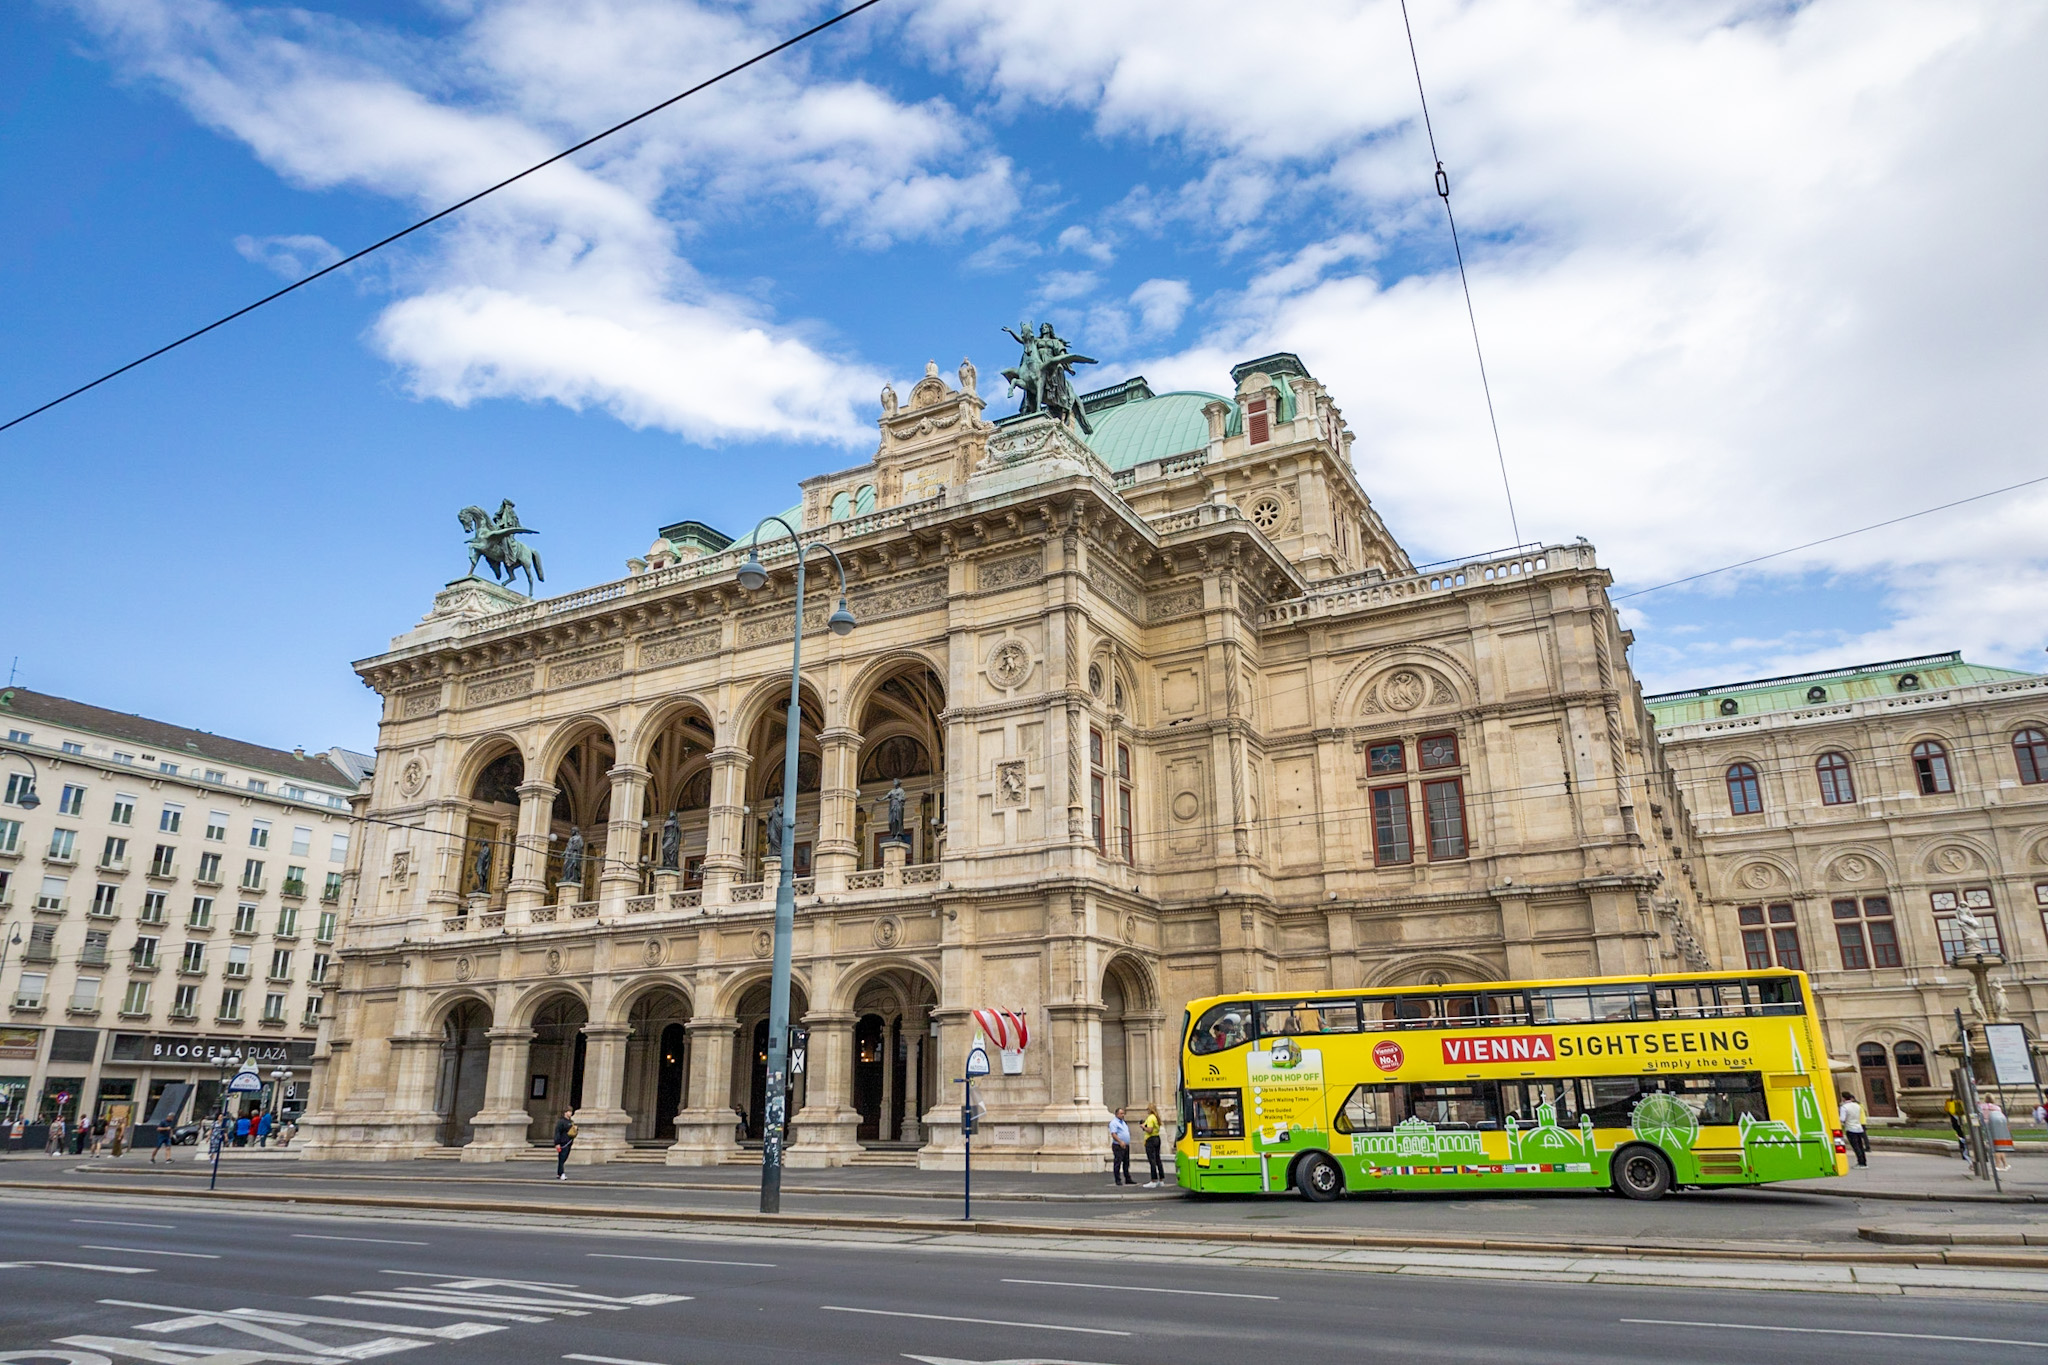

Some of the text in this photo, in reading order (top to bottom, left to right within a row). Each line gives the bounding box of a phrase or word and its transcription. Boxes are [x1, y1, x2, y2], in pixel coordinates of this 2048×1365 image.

[153, 1043, 288, 1060] BIOGEA PLAZA
[1375, 1046, 1399, 1055] Vienna's
[1445, 1030, 1749, 1061] VIENNA SIGHTSEEING
[1379, 1054, 1398, 1065] No.1
[1647, 1057, 1754, 1070] simply the best
[1252, 1072, 1320, 1082] HOP ON HOP OFF
[286, 1085, 295, 1097] 8
